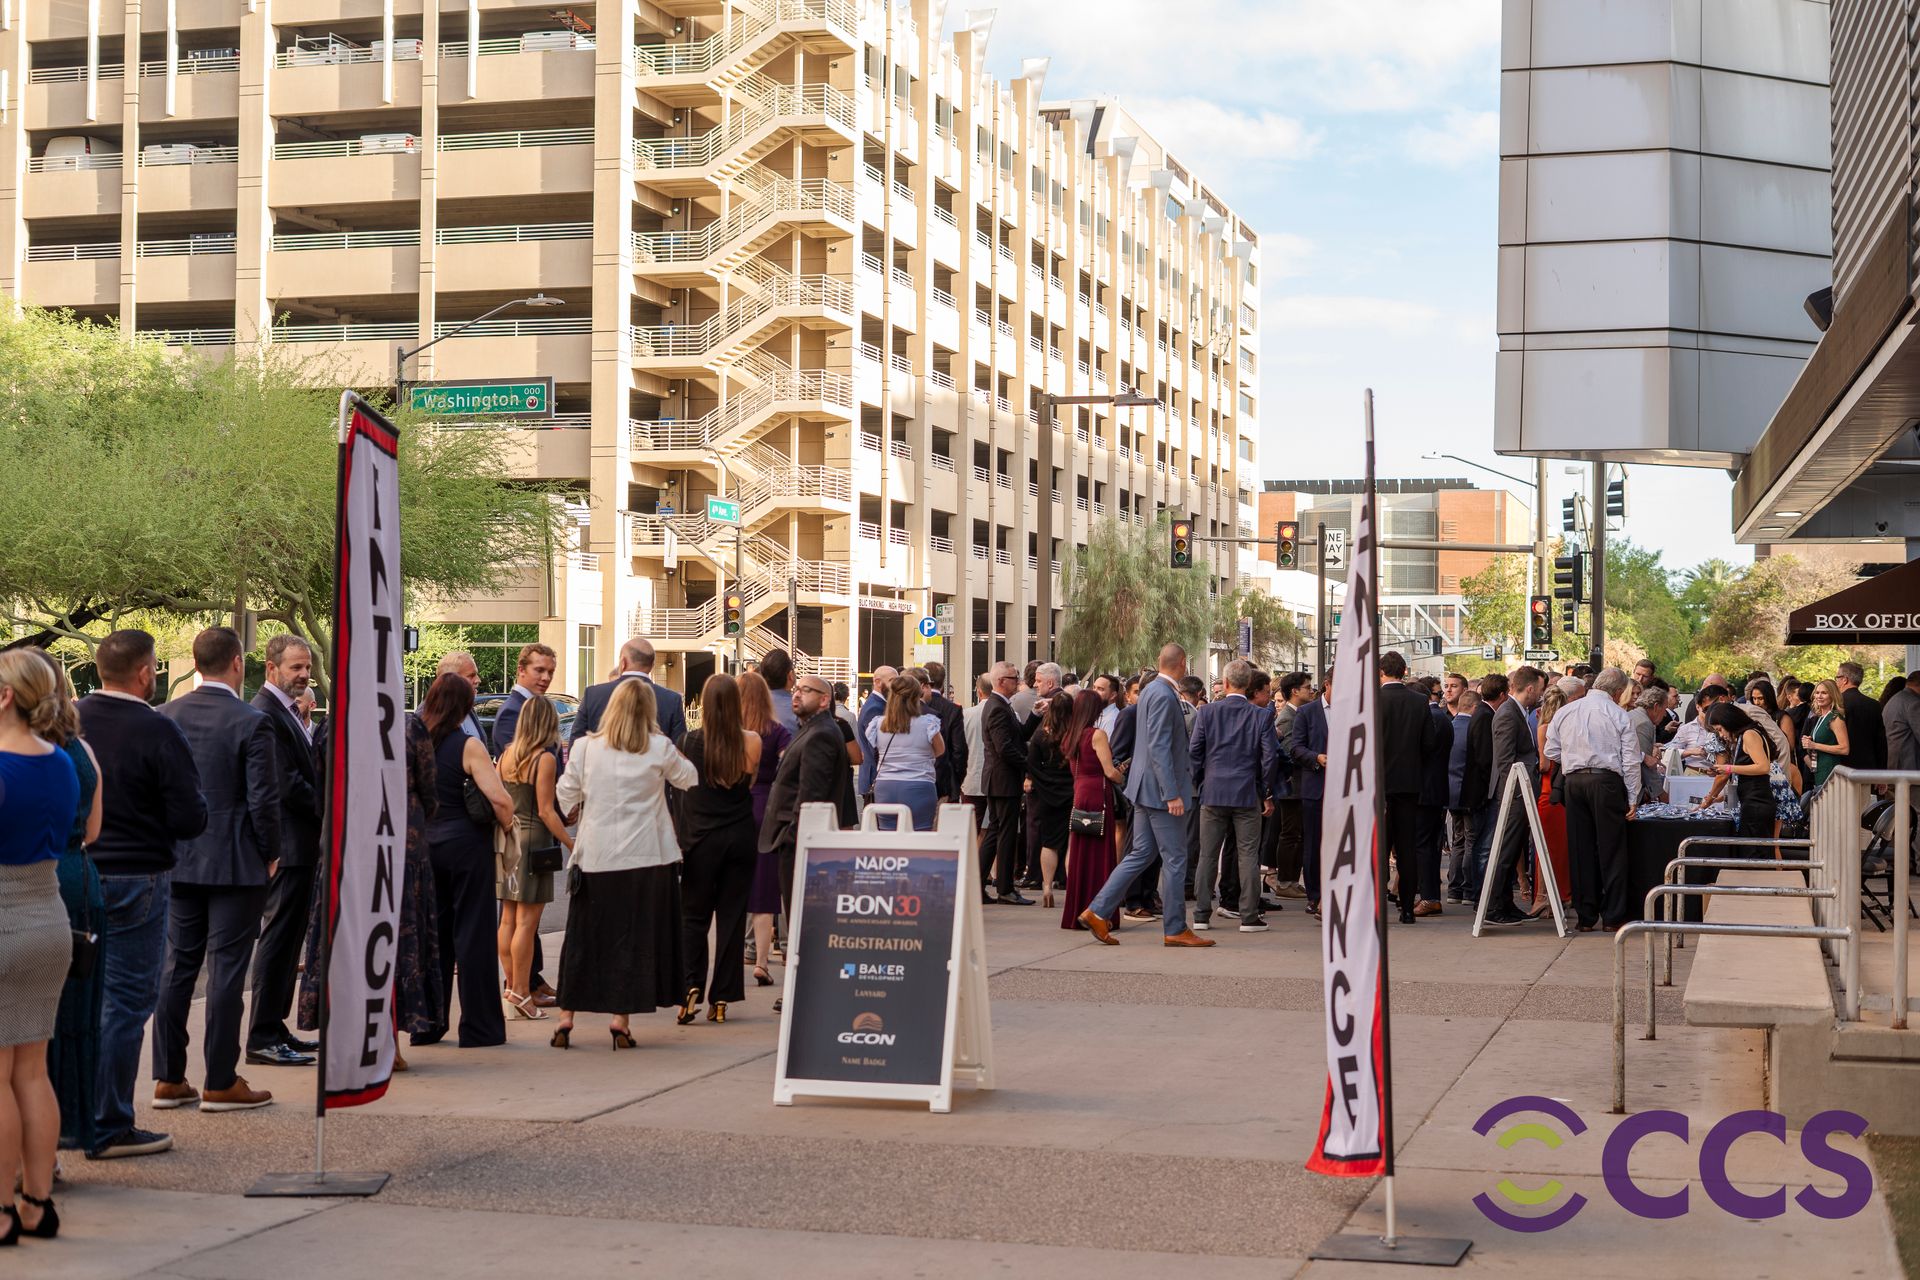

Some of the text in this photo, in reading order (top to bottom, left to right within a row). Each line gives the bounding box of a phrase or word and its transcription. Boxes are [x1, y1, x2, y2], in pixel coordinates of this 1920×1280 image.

[524, 387, 541, 395] 000
[423, 394, 519, 410] Washington
[1324, 533, 1342, 542] NE
[1325, 544, 1342, 553] AY
[923, 620, 935, 635] P
[1815, 613, 1858, 629] BOX
[854, 856, 909, 871] NAIOP
[828, 934, 923, 952] REGISTRATION
[859, 963, 904, 975] BAKER
[837, 1032, 896, 1046] GCON
[842, 1056, 886, 1066] NAME BADGE
